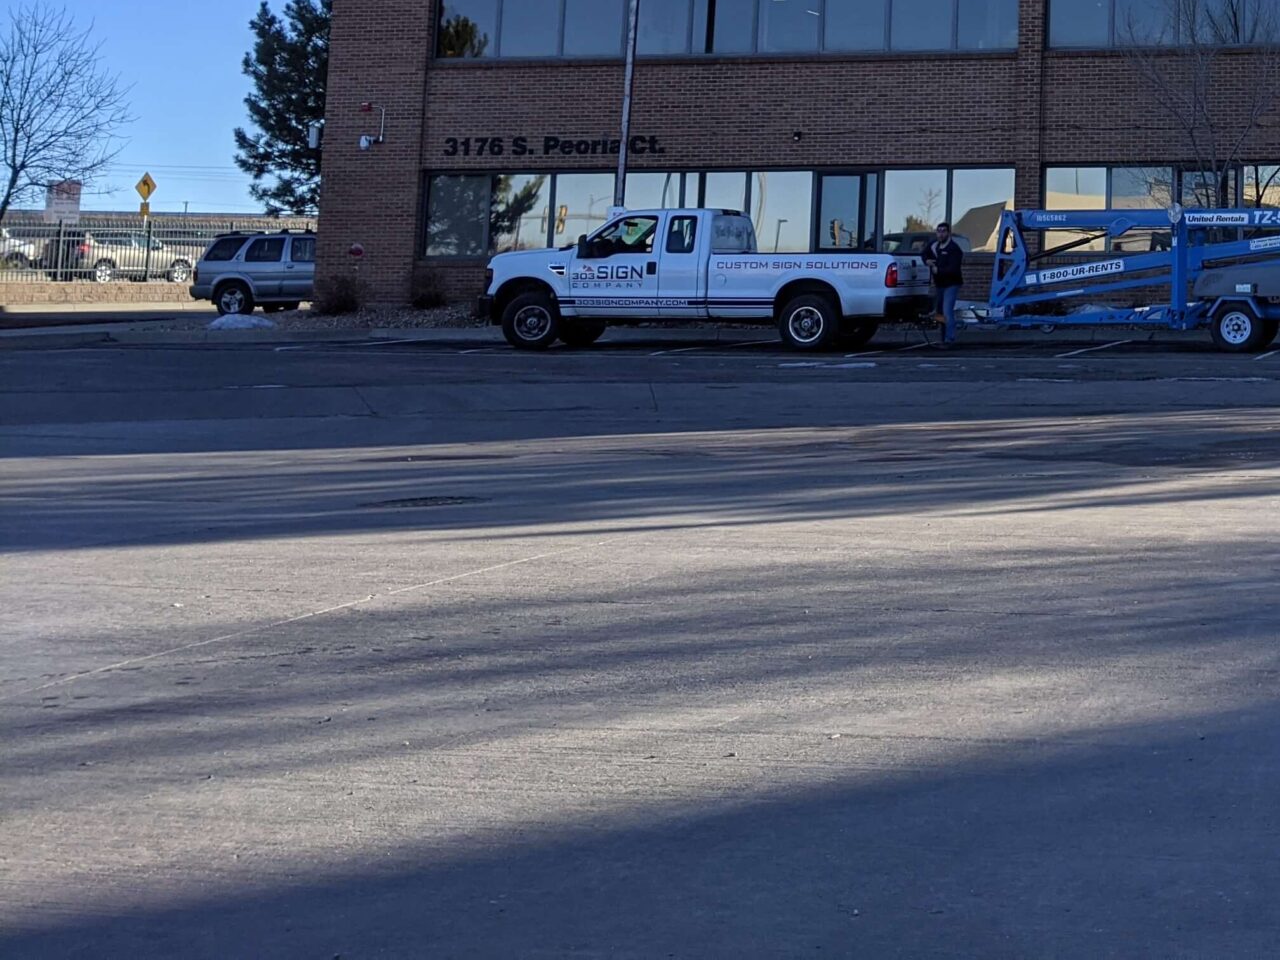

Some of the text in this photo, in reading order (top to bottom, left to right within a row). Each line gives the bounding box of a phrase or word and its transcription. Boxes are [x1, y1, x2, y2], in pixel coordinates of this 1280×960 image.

[444, 134, 666, 157] 3176 S. Peoria Ct.
[1187, 214, 1246, 223] United Rentals
[716, 261, 878, 270] CUSTOM SIGN SOLUTIONS
[1042, 261, 1121, 281] 1-800-UR-RENTS
[572, 265, 644, 280] 303 SIGN
[576, 299, 688, 307] 303SIGNCOMPANY.COM
